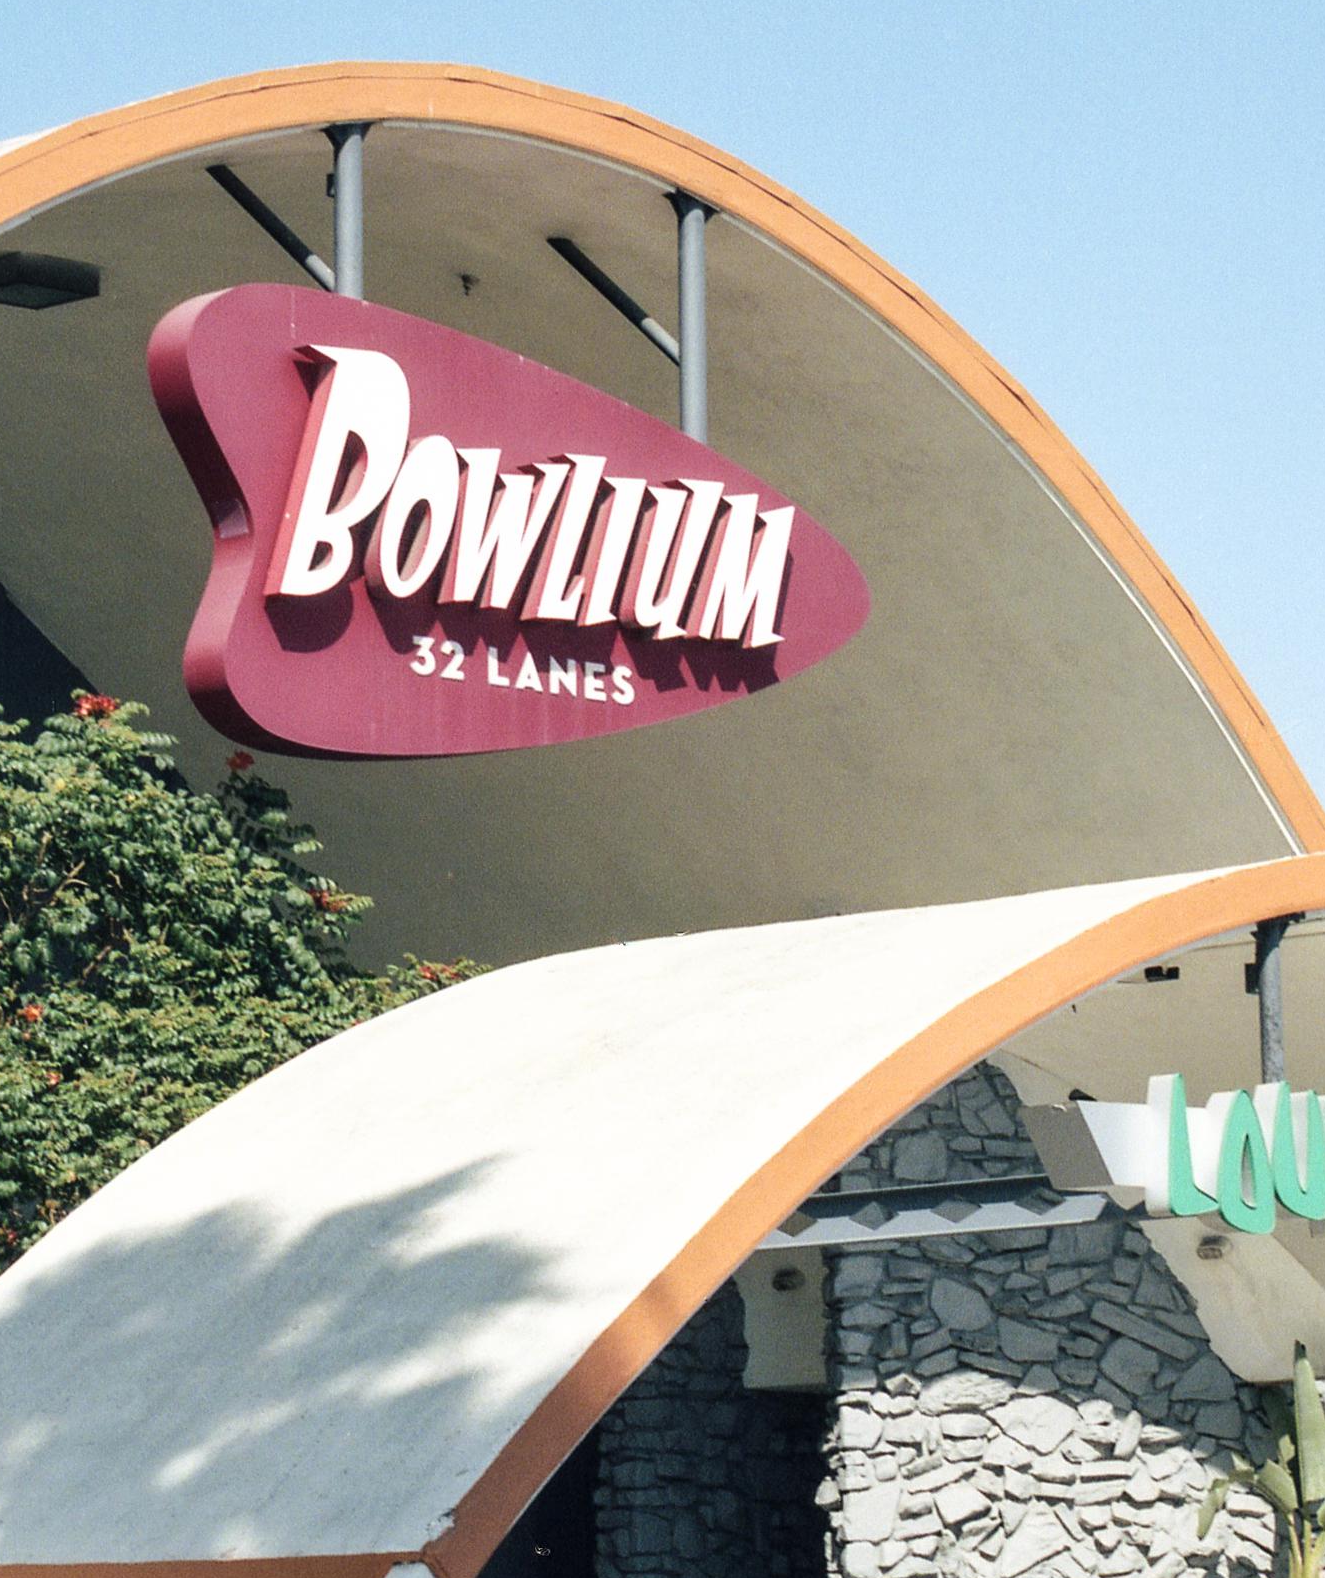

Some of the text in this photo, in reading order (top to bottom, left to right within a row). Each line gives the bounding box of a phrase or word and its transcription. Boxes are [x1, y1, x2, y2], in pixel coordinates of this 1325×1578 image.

[272, 345, 796, 649] BOWLIUM
[410, 634, 636, 705] 32 LANES
